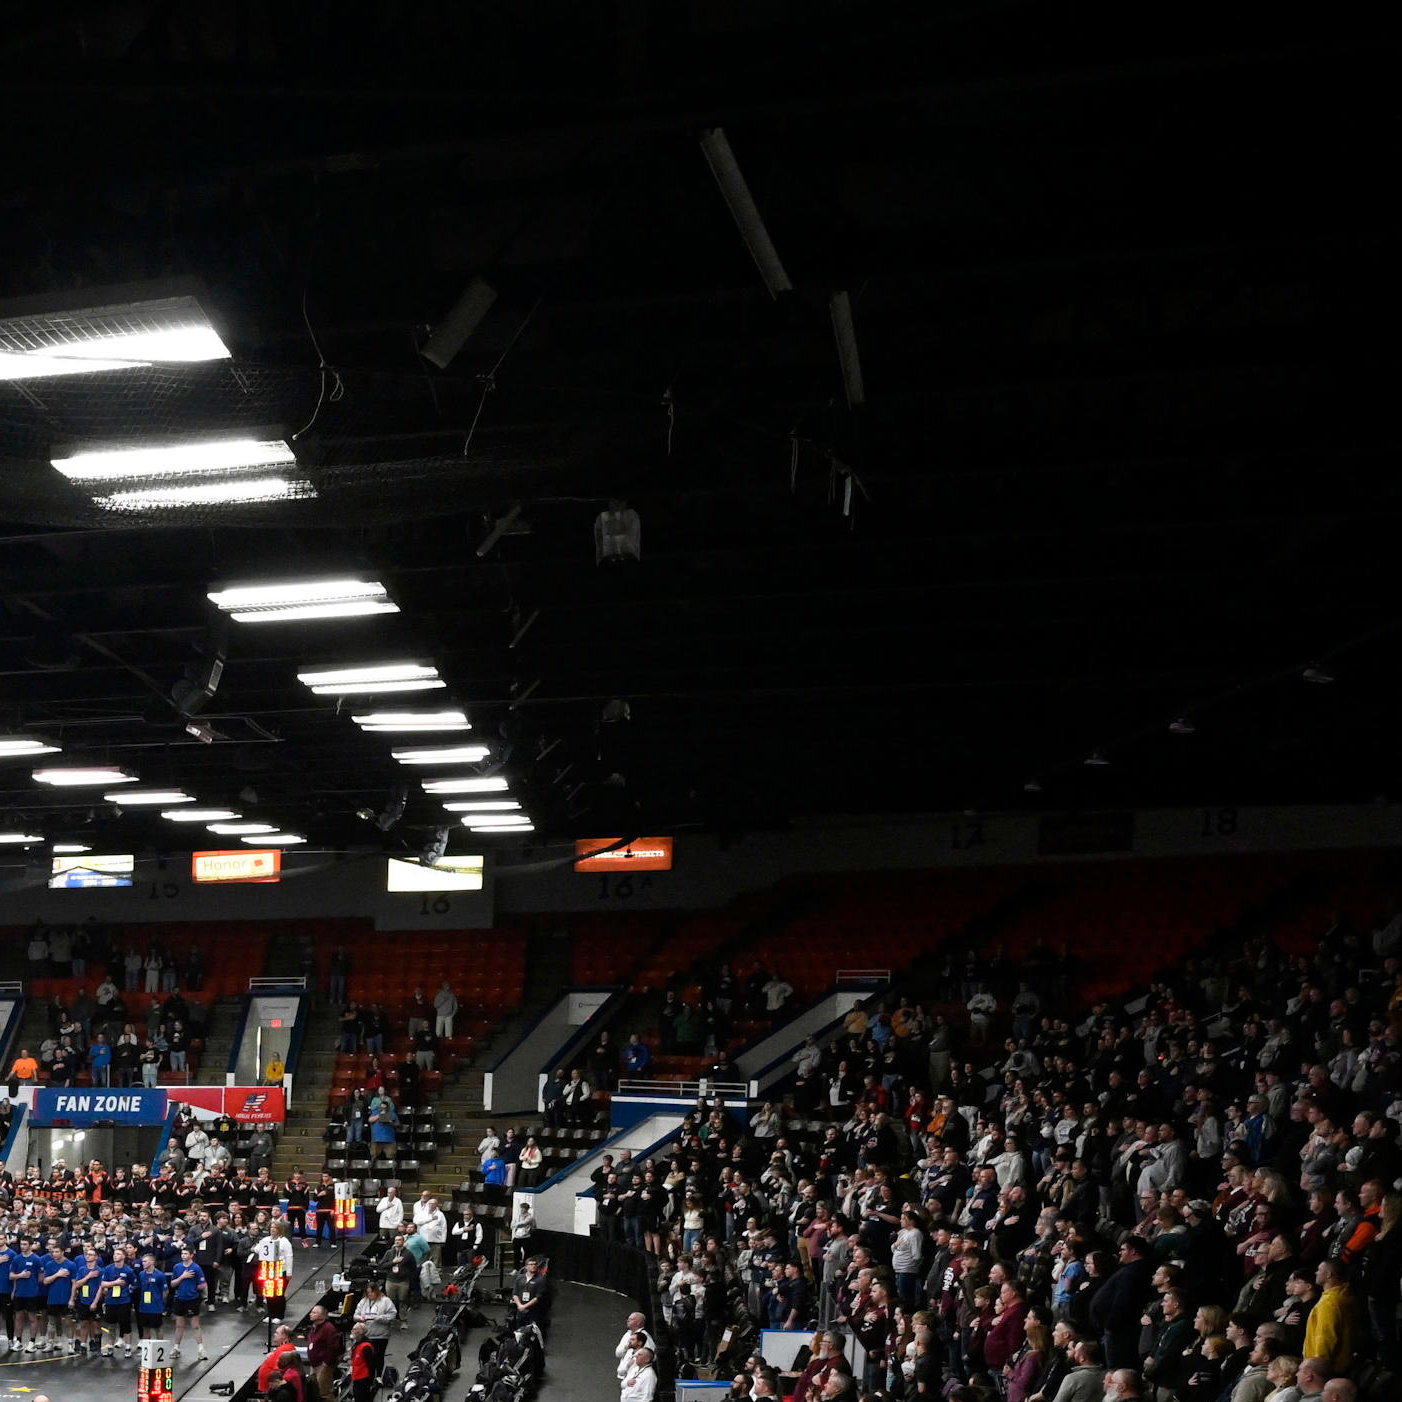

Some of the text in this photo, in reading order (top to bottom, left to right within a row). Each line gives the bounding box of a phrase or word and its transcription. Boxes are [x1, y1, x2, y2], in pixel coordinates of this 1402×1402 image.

[203, 857, 247, 872] Honor
[597, 875, 634, 899] 16
[419, 895, 451, 915] 16
[56, 1096, 141, 1112] FAN ZONE
[263, 1245, 269, 1256] 3
[157, 1347, 164, 1362] 2
[156, 1368, 171, 1379] 0 0
[166, 1379, 172, 1389] 0
